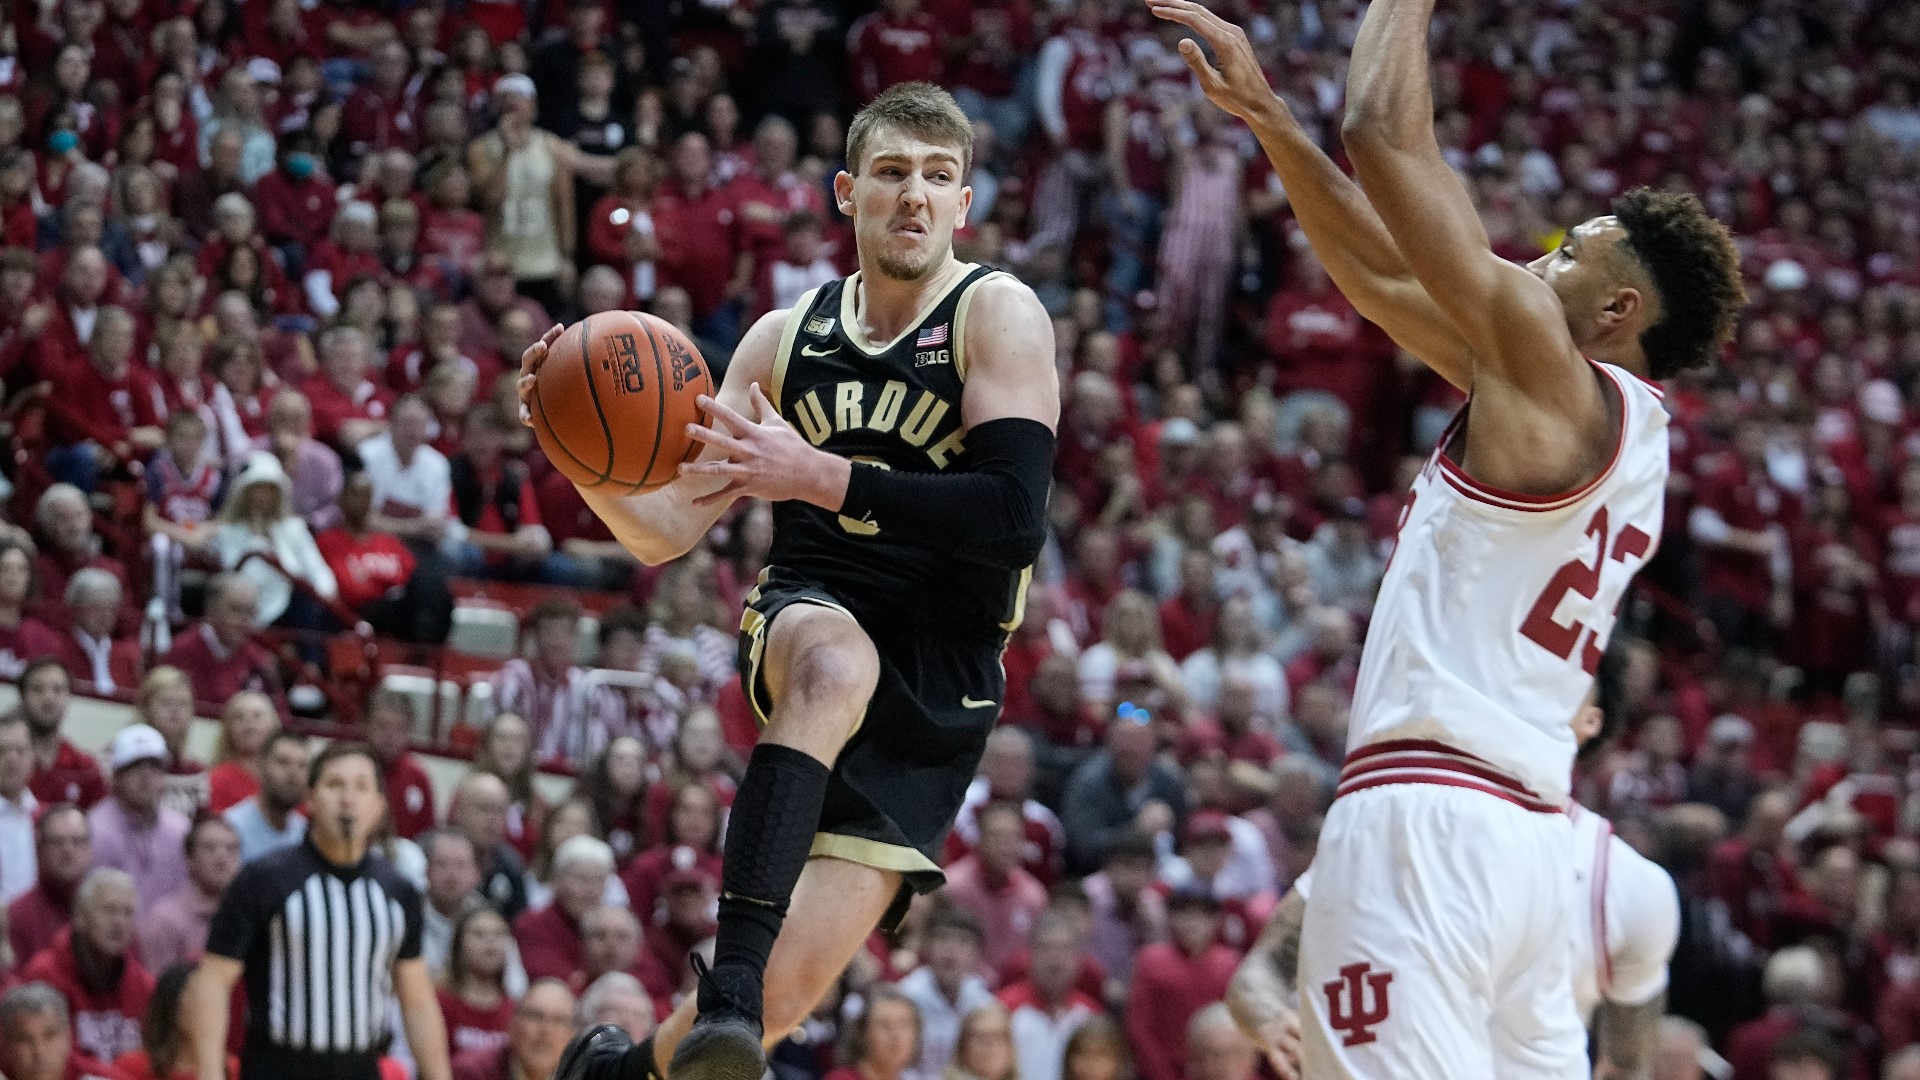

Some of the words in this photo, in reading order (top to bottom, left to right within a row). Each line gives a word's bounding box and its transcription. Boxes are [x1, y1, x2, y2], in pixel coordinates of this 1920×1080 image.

[614, 333, 645, 393] PRO
[662, 333, 684, 392] adidas
[788, 379, 967, 471] URDUE
